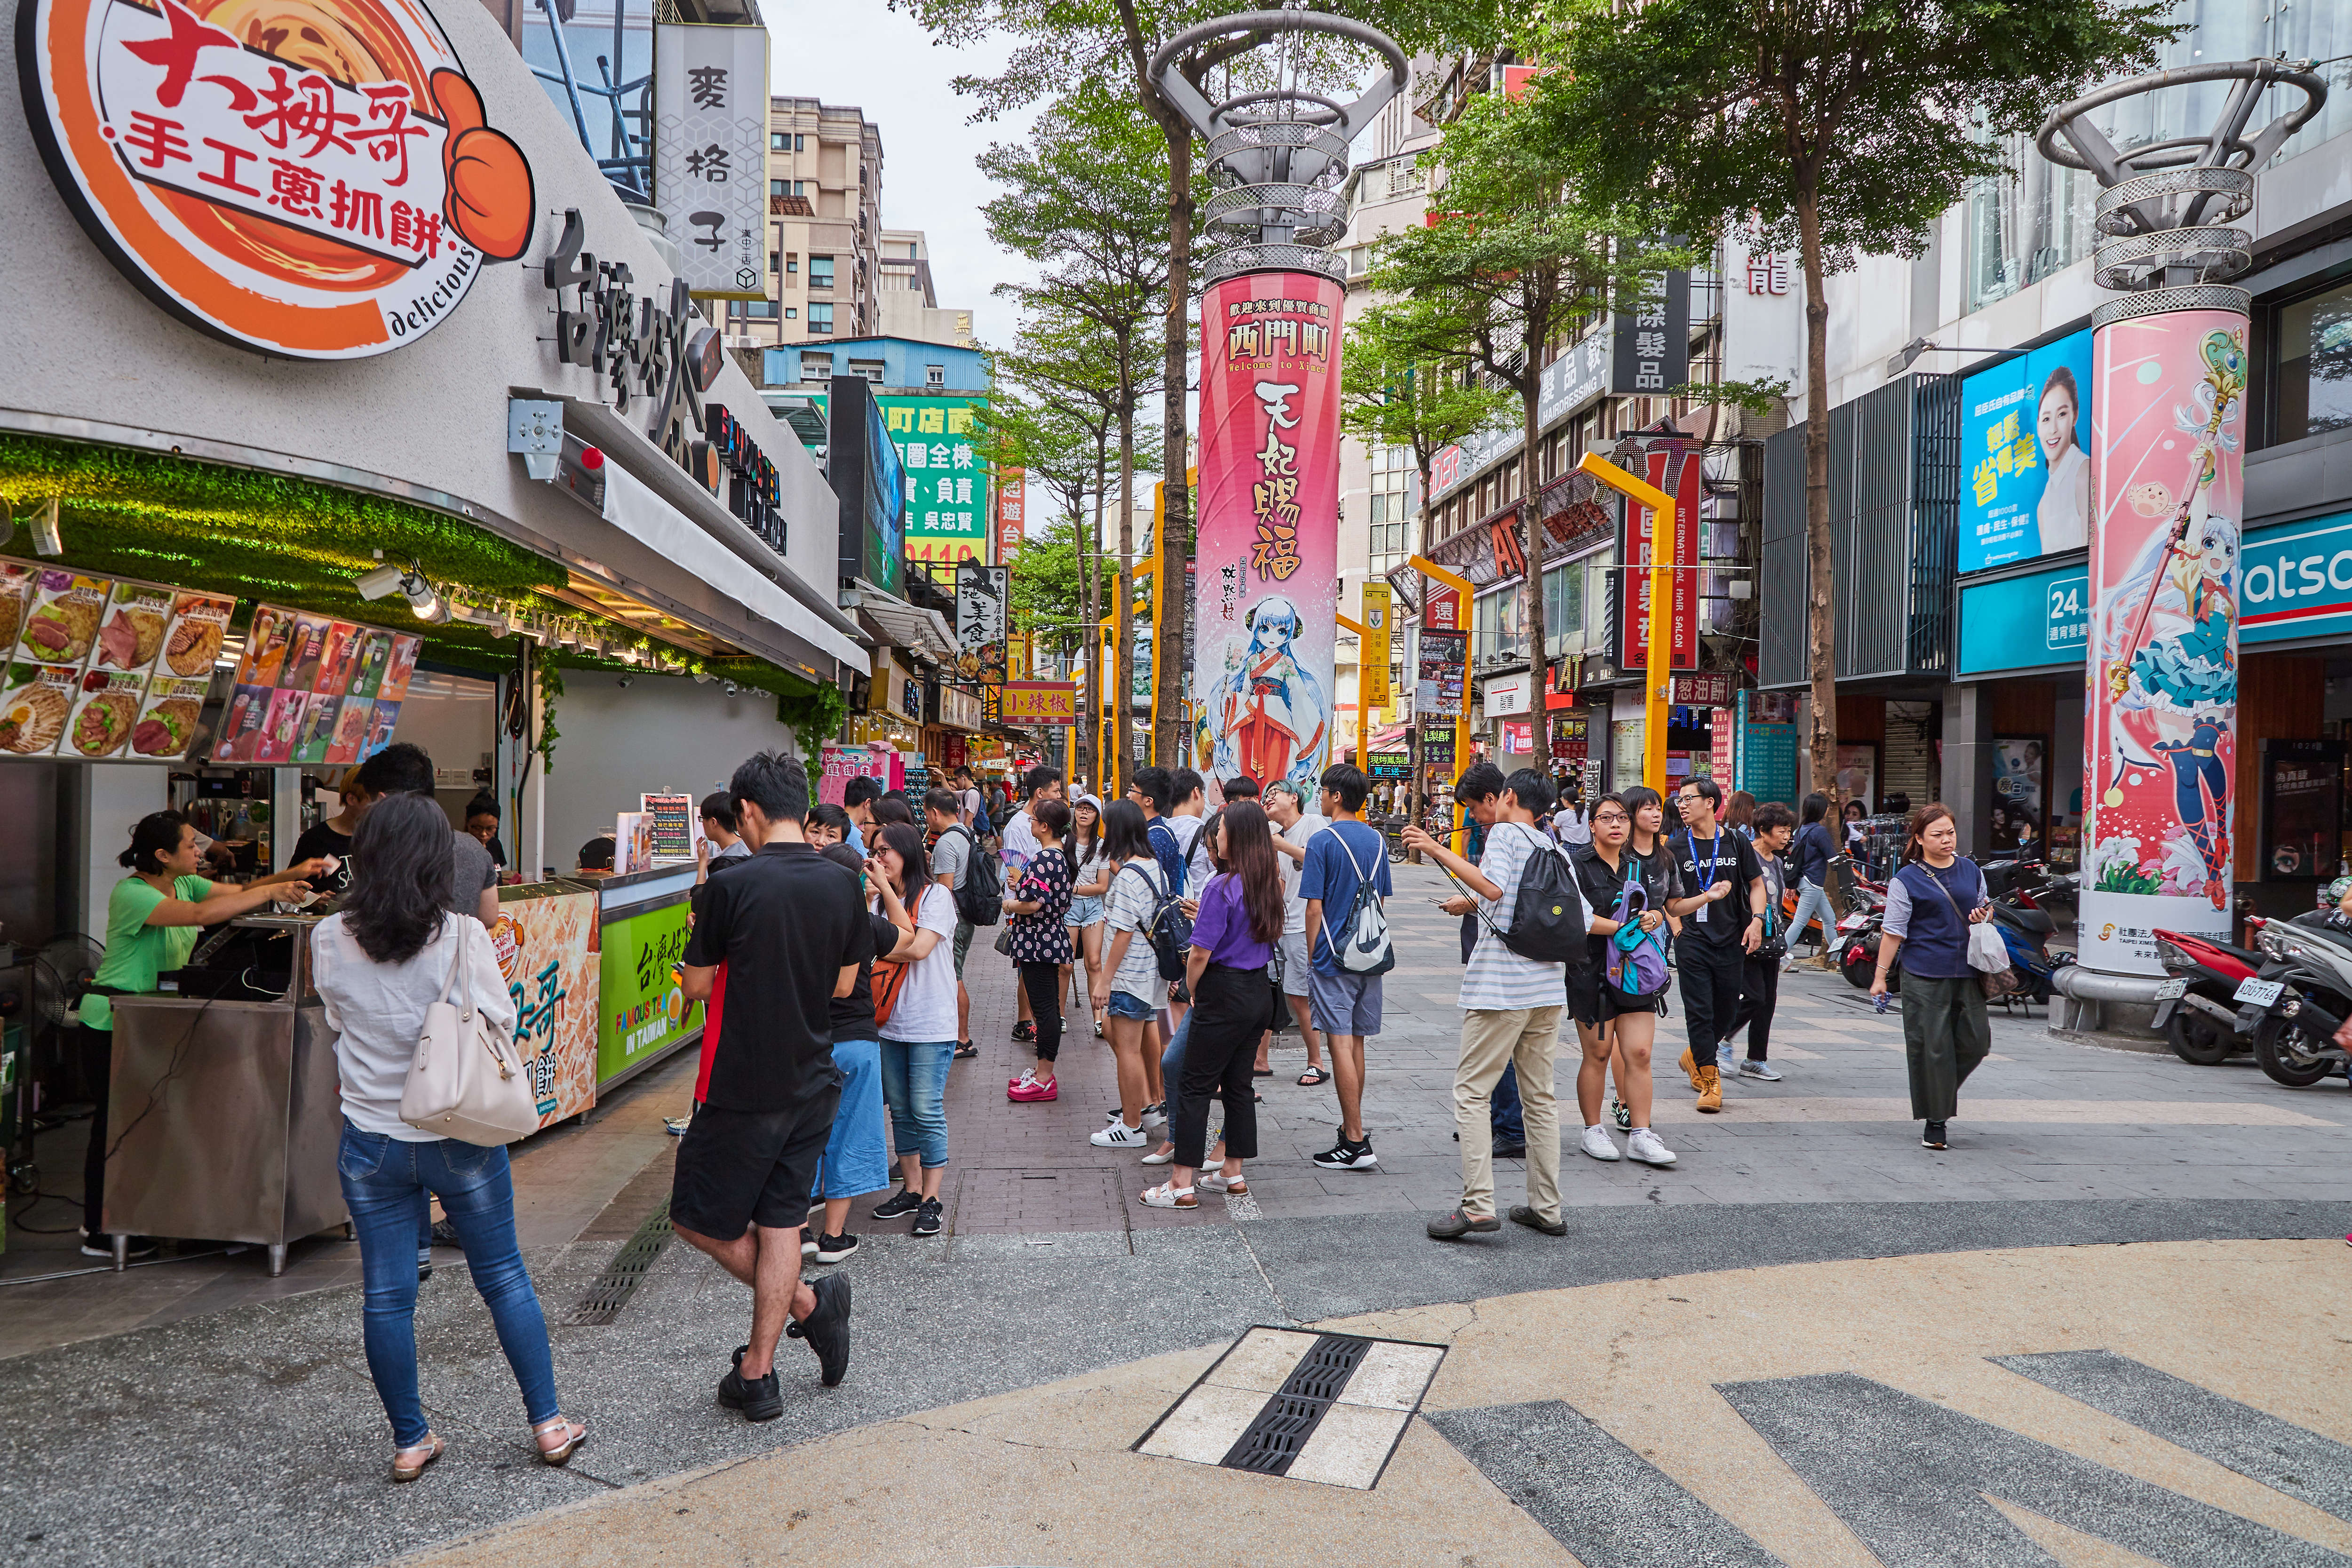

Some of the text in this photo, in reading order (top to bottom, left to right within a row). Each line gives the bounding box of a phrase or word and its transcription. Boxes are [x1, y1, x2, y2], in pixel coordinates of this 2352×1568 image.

[685, 66, 731, 253] 麥格子
[124, 110, 445, 260] 手工蔥抓餅
[741, 229, 751, 265] 漢中二店
[390, 244, 475, 337] delicious
[1229, 320, 1329, 361] 西門町
[1229, 360, 1326, 374] Welcome to Ximen
[1543, 376, 1597, 422] HAIRDRESSING
[1975, 387, 2025, 417] 屈臣氏自有品牌
[880, 406, 973, 434] 町店面
[1986, 409, 2020, 454] 輕鬆
[1252, 381, 1302, 581] 天妃賜福
[1972, 432, 2037, 508] 省得美
[924, 511, 973, 532] 吳忠賢
[1490, 509, 1527, 579] AT
[2238, 549, 2352, 604] atso
[2051, 588, 2079, 620] 24
[1558, 653, 1586, 692] AT
[1006, 692, 1071, 714] 小辣椒
[827, 764, 870, 776] 運得主
[951, 737, 961, 766] 甜不辣
[1374, 766, 1408, 776] 買三送一
[2238, 984, 2278, 1001] ADU-7766
[616, 993, 667, 1035] FAMOUS TEA
[626, 1016, 667, 1056] IN TAIWAN
[539, 1102, 556, 1114] pancake
